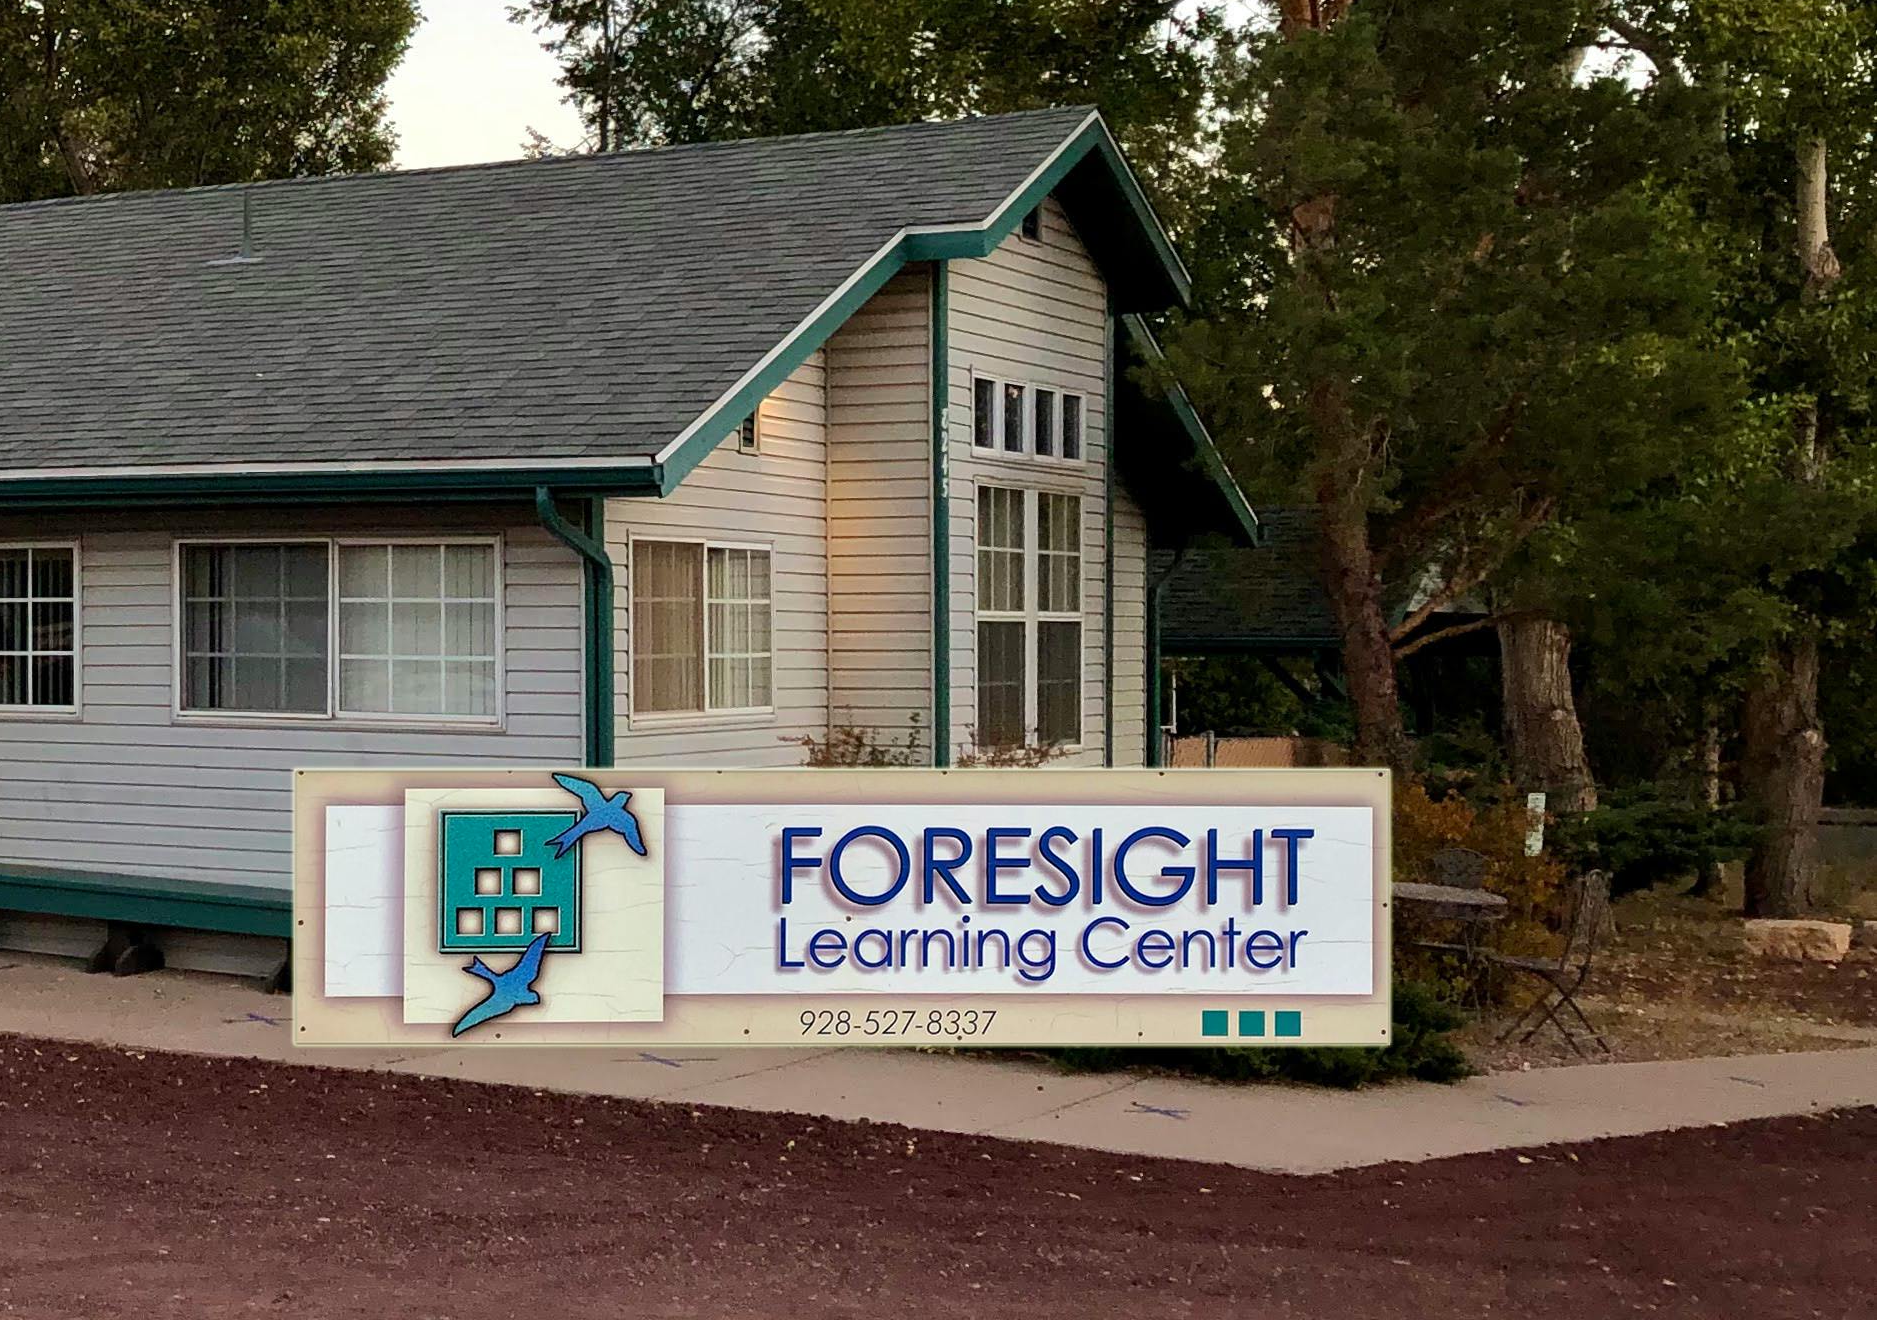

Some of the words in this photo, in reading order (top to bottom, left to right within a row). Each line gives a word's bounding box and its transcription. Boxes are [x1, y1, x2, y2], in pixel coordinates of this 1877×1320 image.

[781, 825, 1315, 907] FORESIGHT
[779, 915, 1057, 982] Learning
[1081, 916, 1310, 969] Center
[799, 1010, 998, 1036] 928-527-8337
